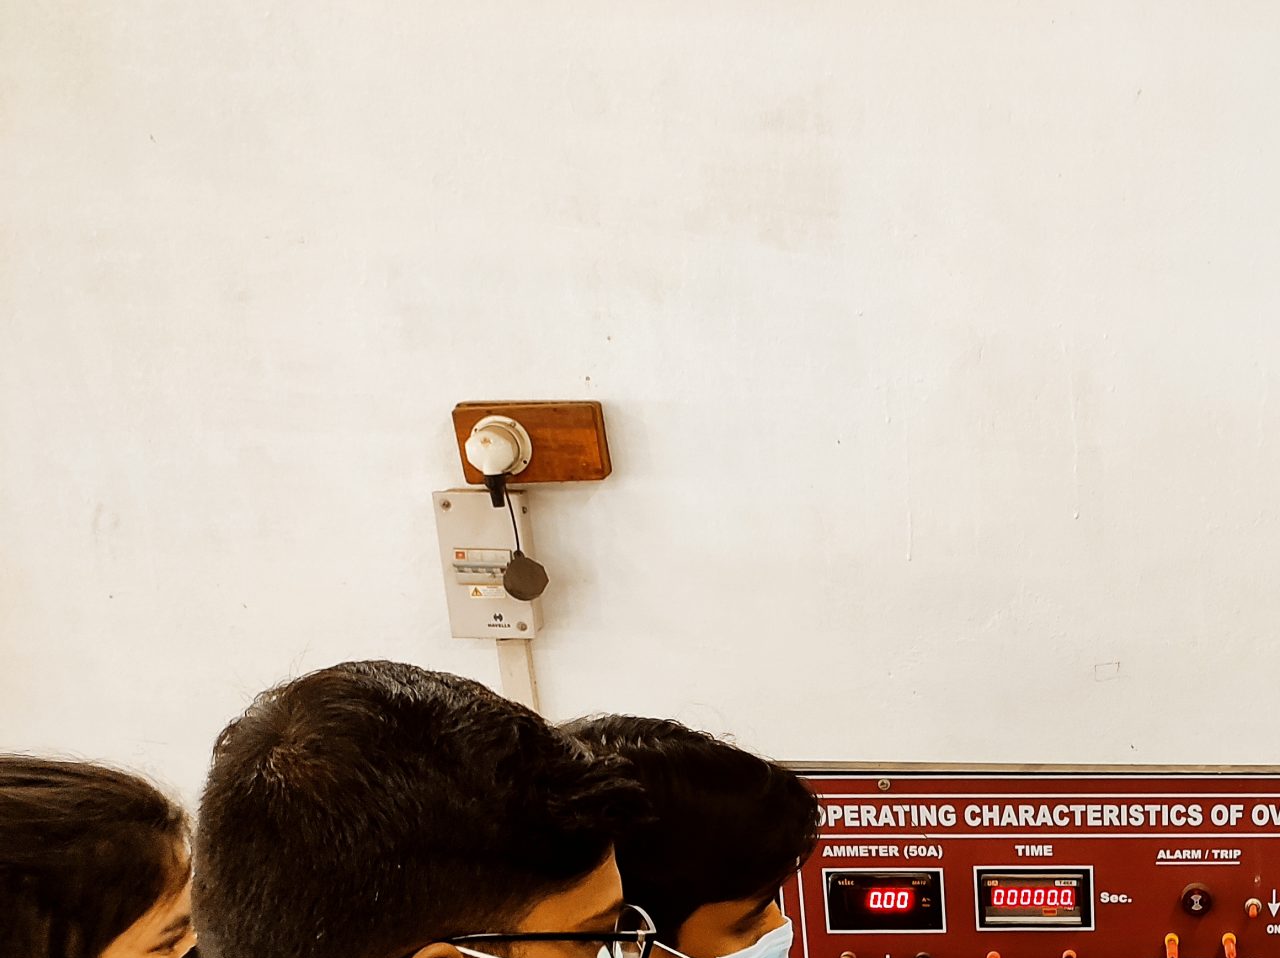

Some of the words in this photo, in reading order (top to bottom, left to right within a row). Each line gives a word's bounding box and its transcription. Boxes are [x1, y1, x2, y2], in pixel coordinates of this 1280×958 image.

[964, 804, 1203, 827] CHARACTERISTICS
[1210, 804, 1244, 826] OF
[822, 845, 900, 857] AMMETER
[903, 845, 943, 860] (50A)
[1015, 845, 1053, 857] TIME
[1157, 849, 1202, 860] ALARM
[1212, 849, 1242, 860] TRIP
[1100, 891, 1133, 904] Sec.
